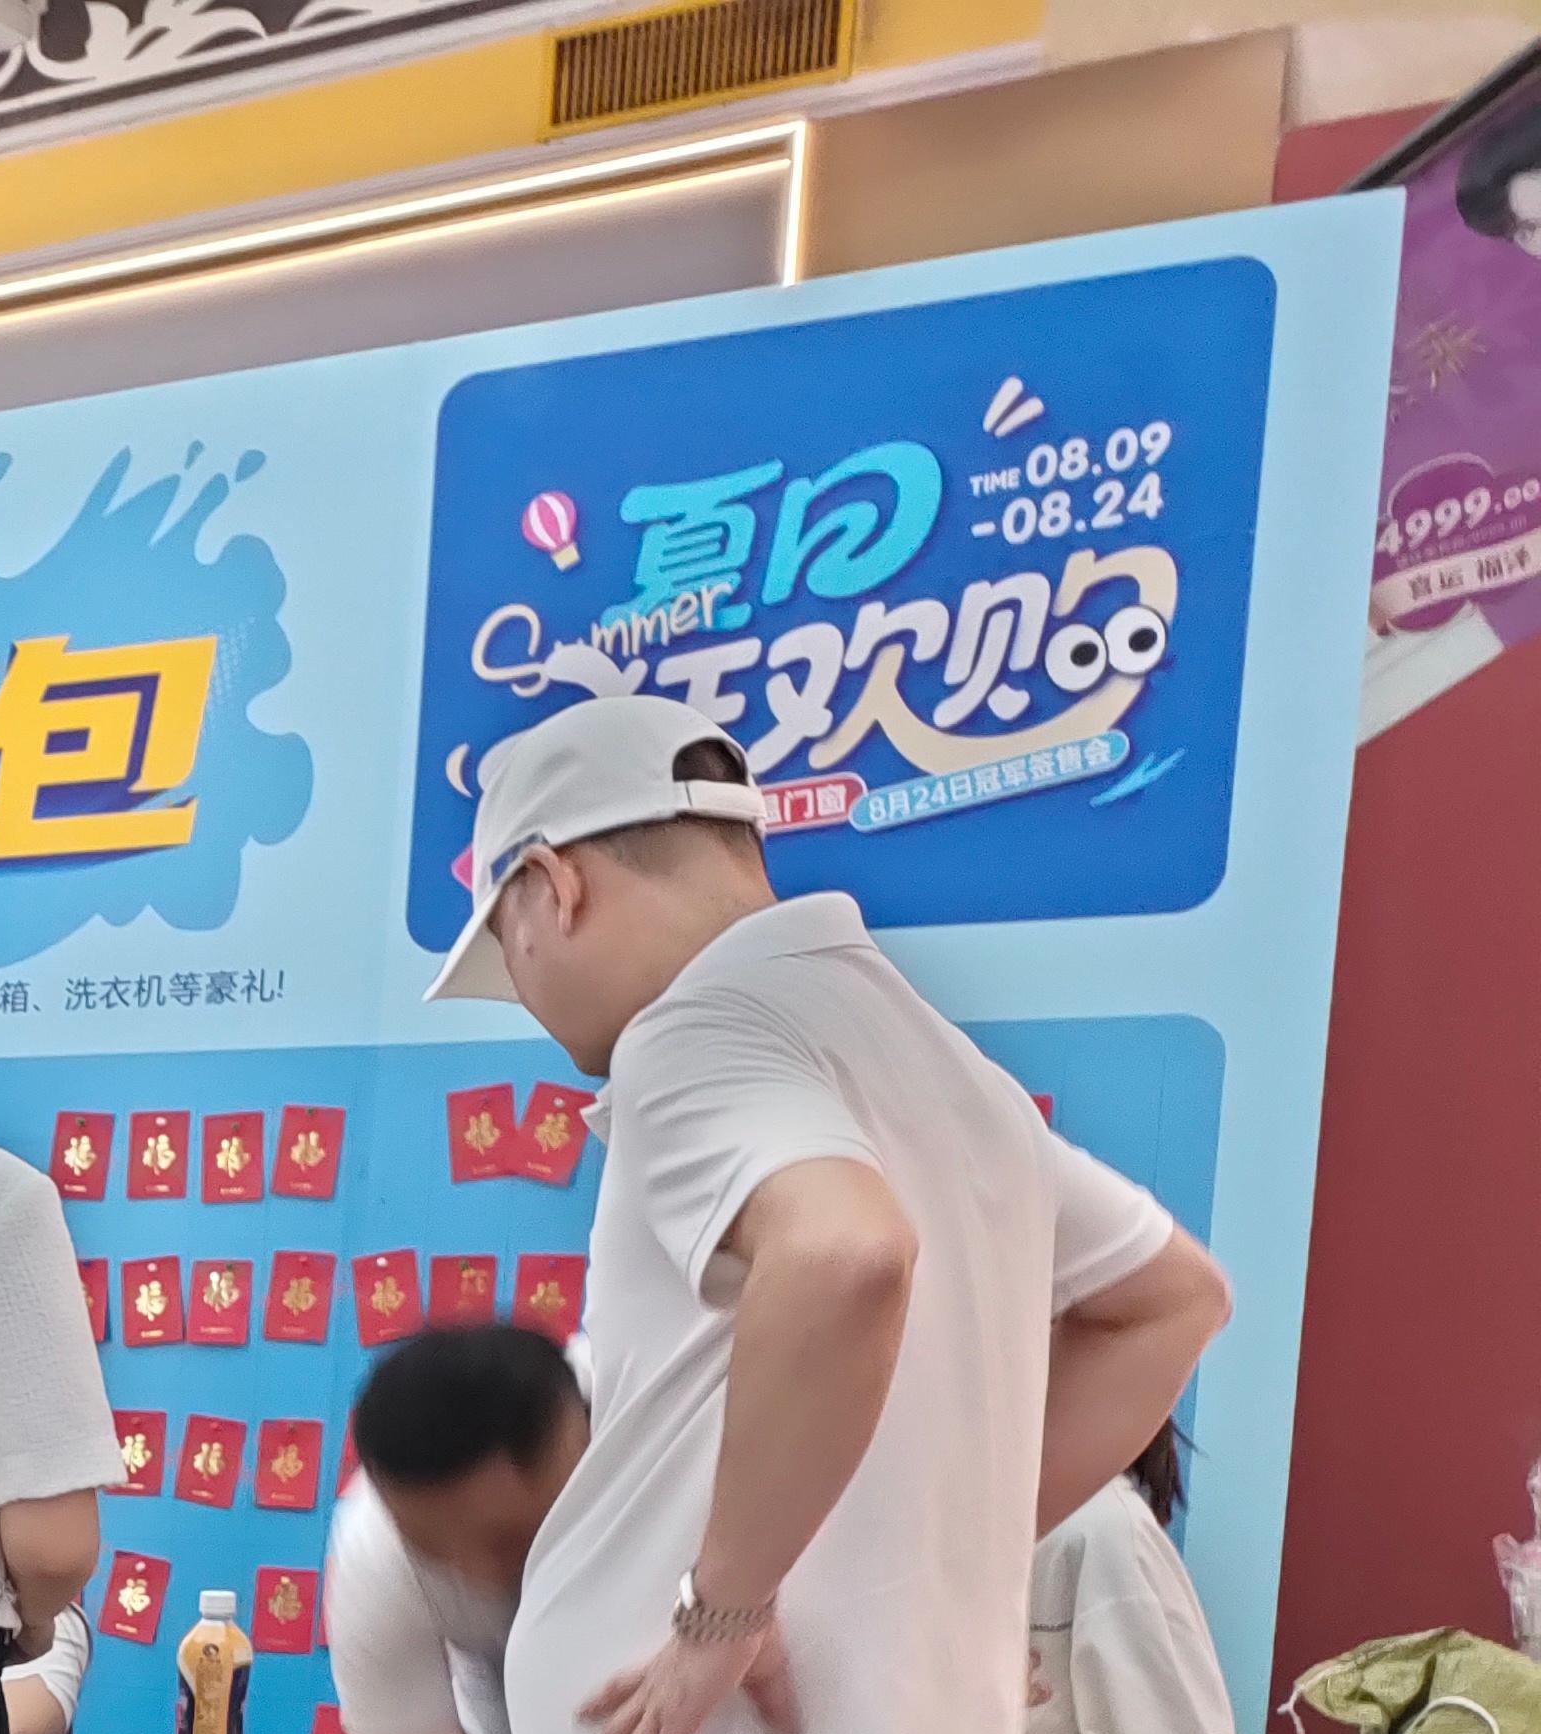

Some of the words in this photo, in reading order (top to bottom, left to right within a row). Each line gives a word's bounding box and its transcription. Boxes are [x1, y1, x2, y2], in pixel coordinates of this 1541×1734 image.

[969, 467, 1021, 497] TIME
[1026, 419, 1172, 487] 08.09
[971, 471, 1164, 545] -08.24
